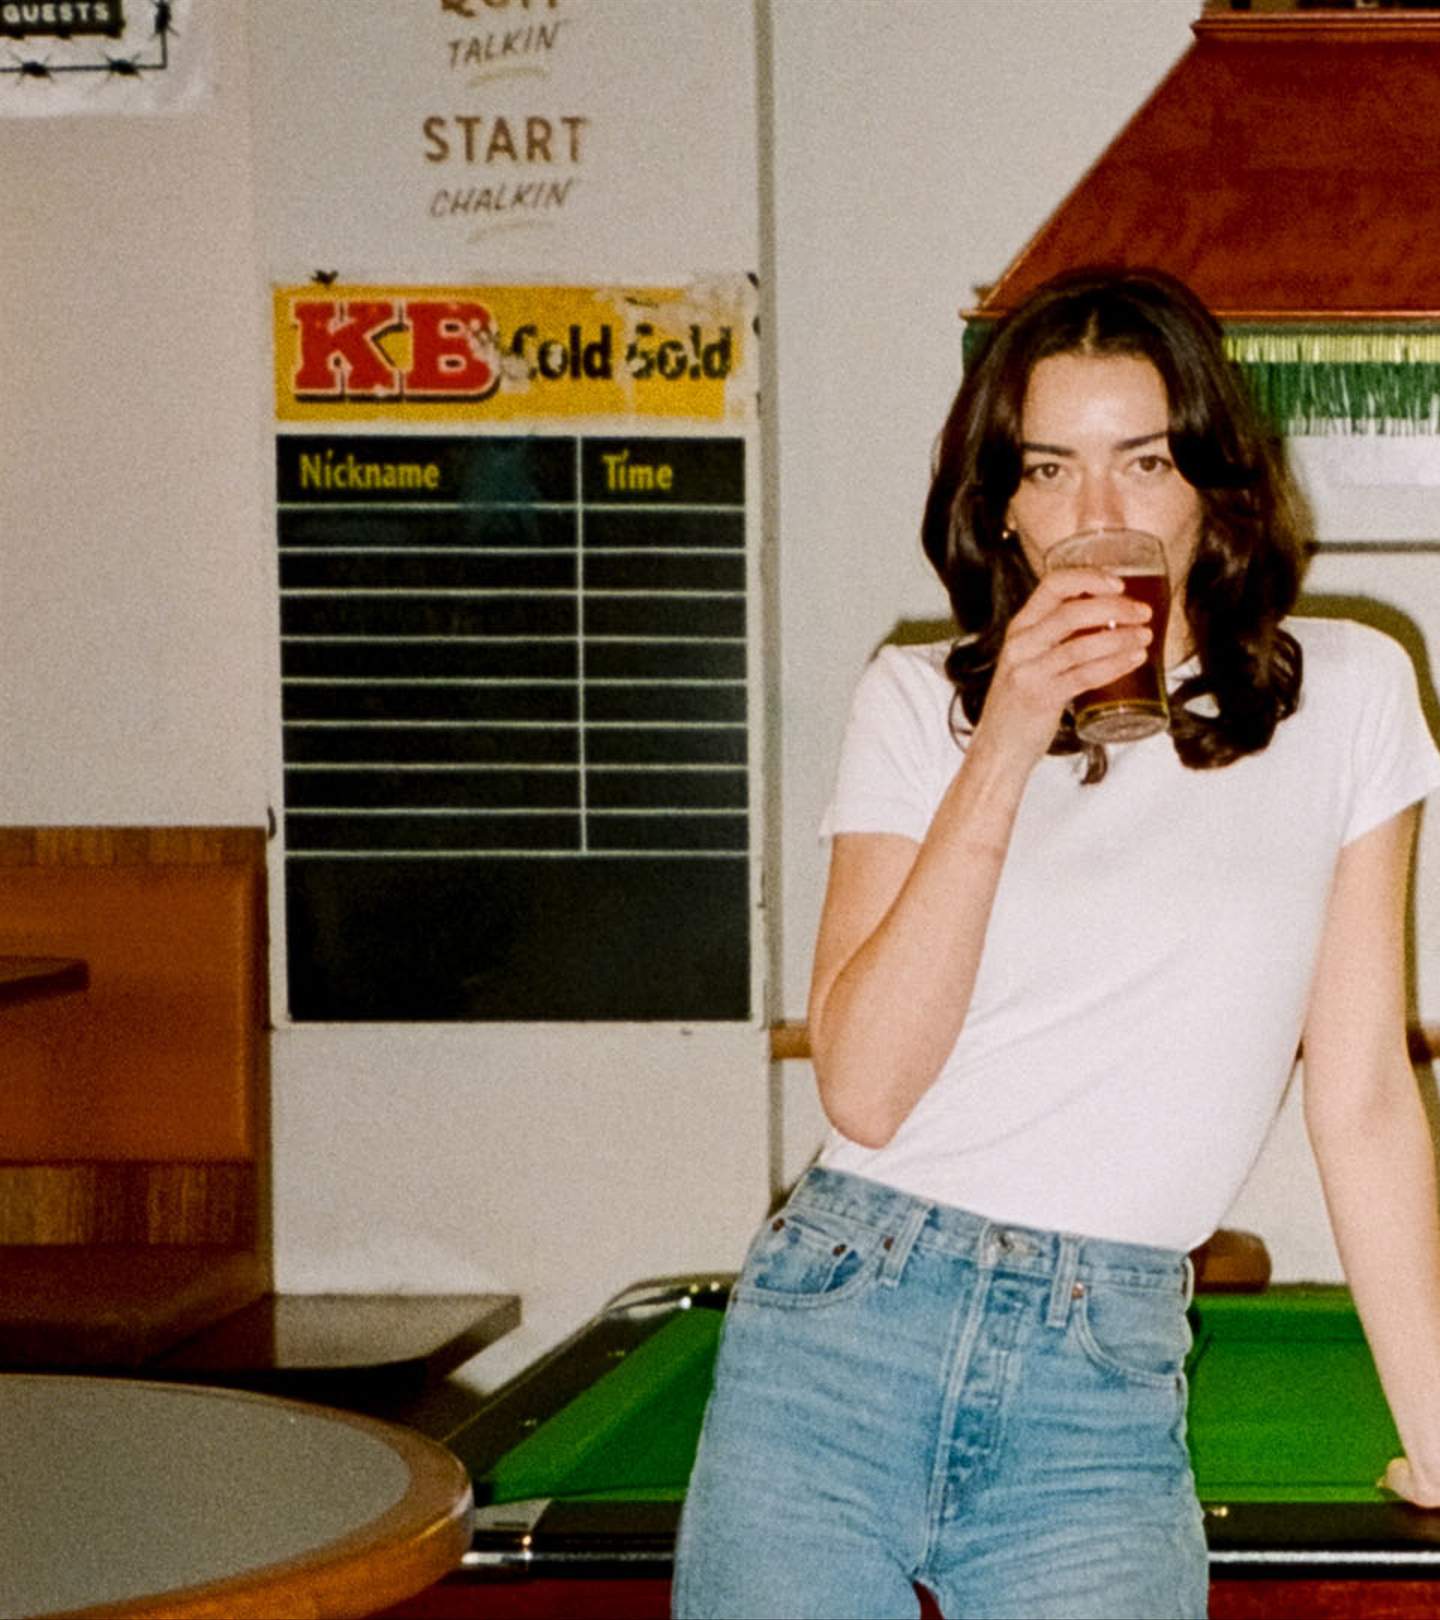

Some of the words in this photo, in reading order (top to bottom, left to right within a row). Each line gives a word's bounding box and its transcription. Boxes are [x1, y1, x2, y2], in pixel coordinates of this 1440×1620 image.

[423, 115, 590, 163] START
[292, 297, 501, 402] KB
[301, 450, 440, 489] Nickname
[602, 449, 673, 489] Time
